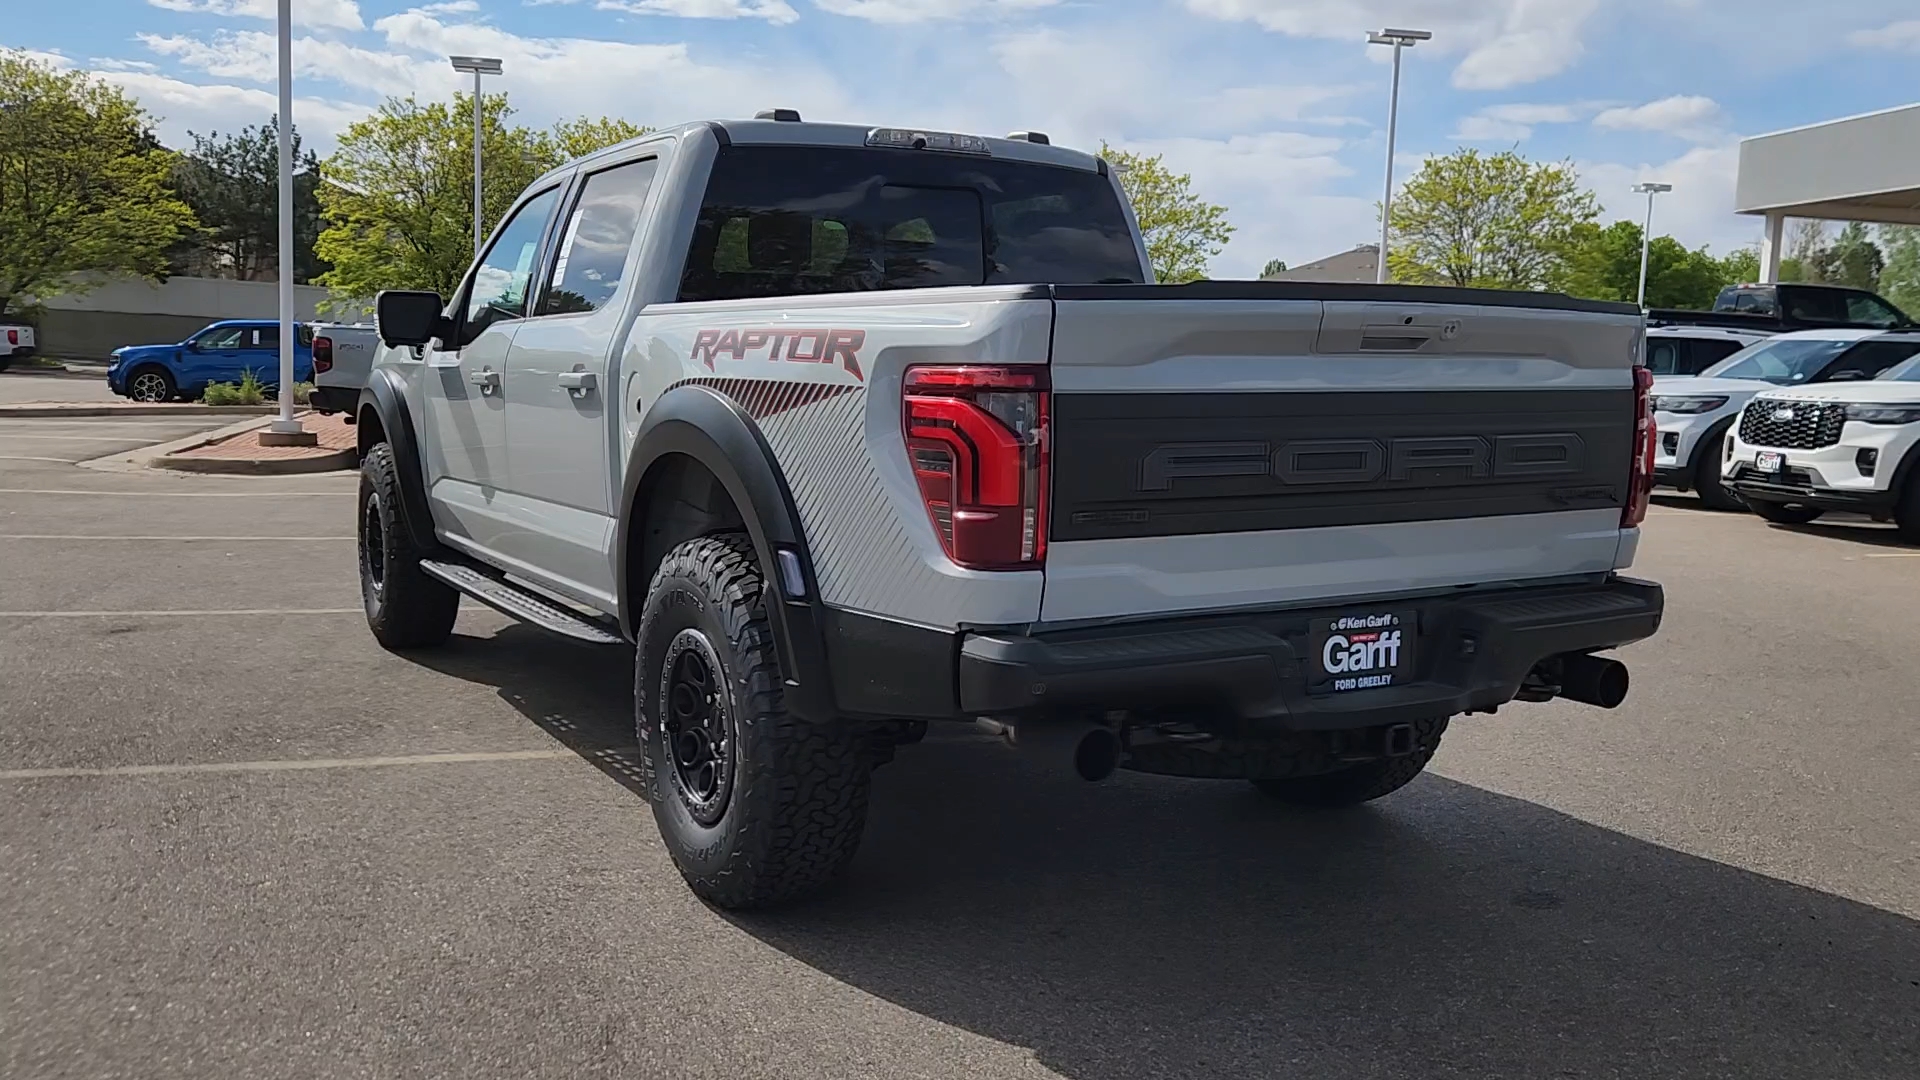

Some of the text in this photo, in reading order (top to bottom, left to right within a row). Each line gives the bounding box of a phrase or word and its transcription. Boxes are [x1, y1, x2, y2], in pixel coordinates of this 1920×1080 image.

[689, 328, 866, 382] RAPTOR
[1138, 432, 1588, 491] FORD
[1347, 613, 1392, 628] Ken Garff
[1323, 630, 1401, 674] Garff
[1335, 674, 1392, 691] FORD GREELEY
